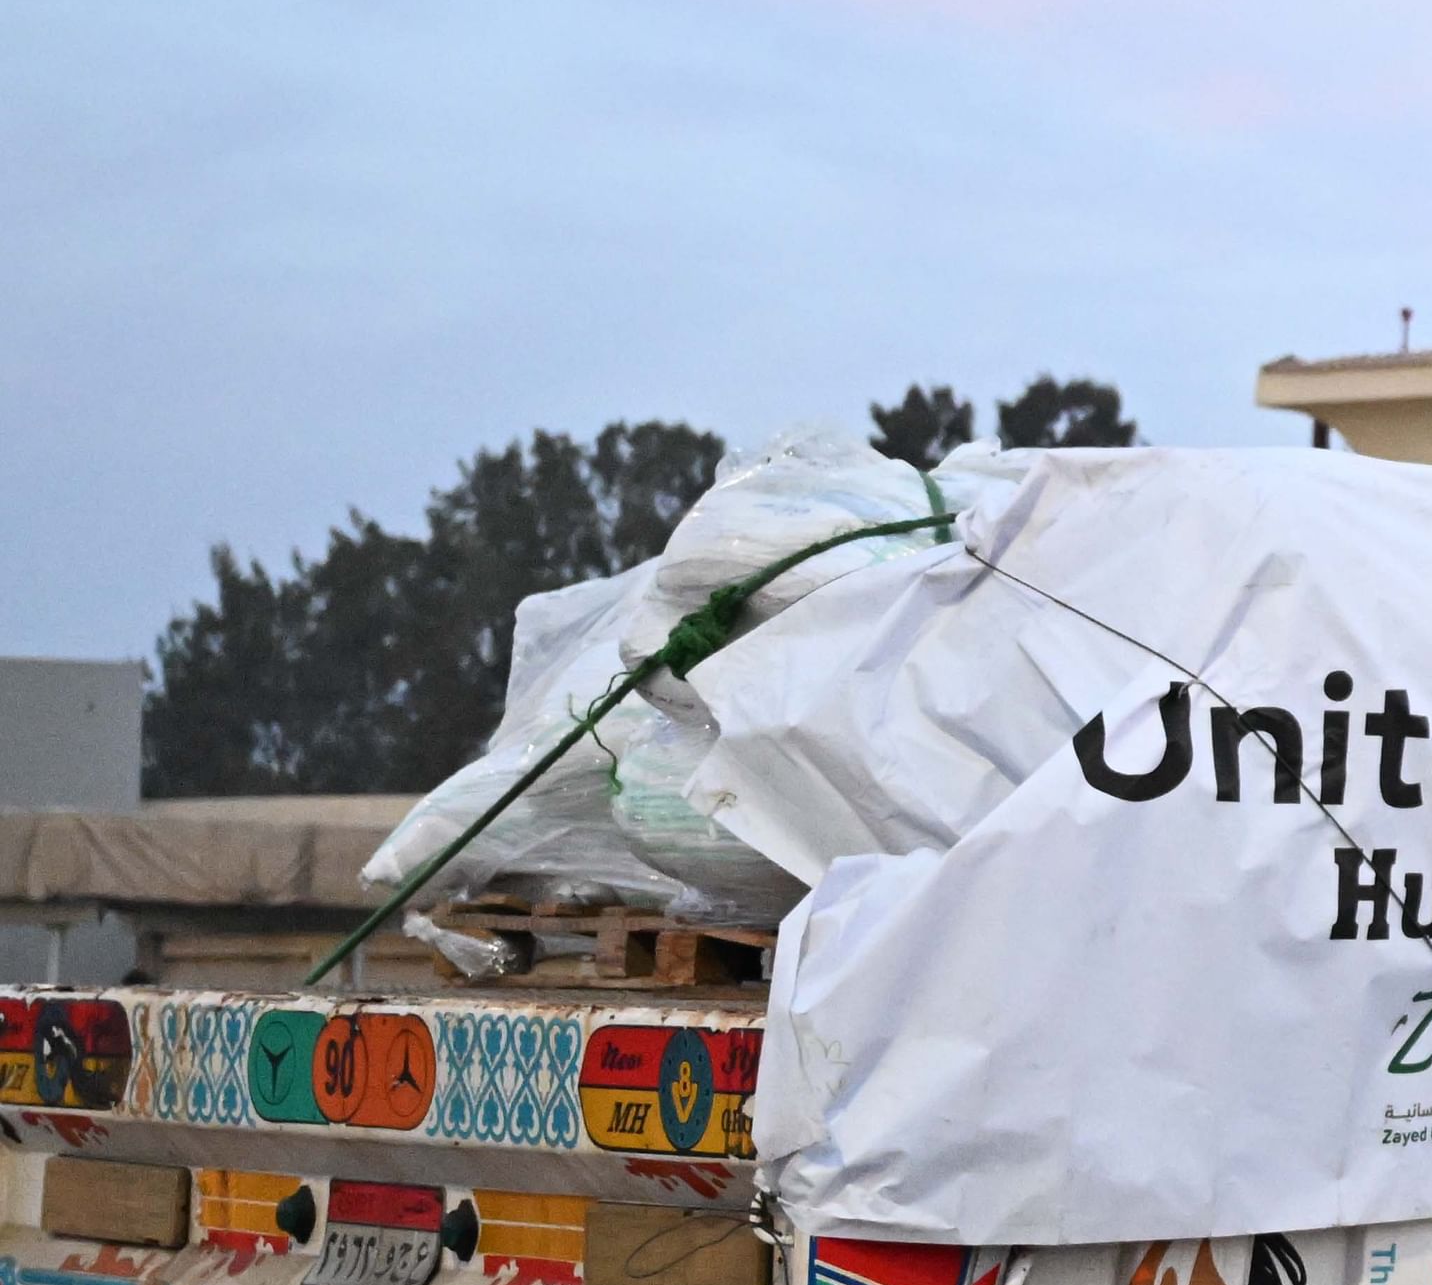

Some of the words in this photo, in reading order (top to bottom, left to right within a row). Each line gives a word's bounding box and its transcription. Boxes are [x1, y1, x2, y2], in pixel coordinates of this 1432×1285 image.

[324, 1039, 355, 1096] 90
[607, 1101, 652, 1135] MH
[1382, 1127, 1428, 1147] Zayed
